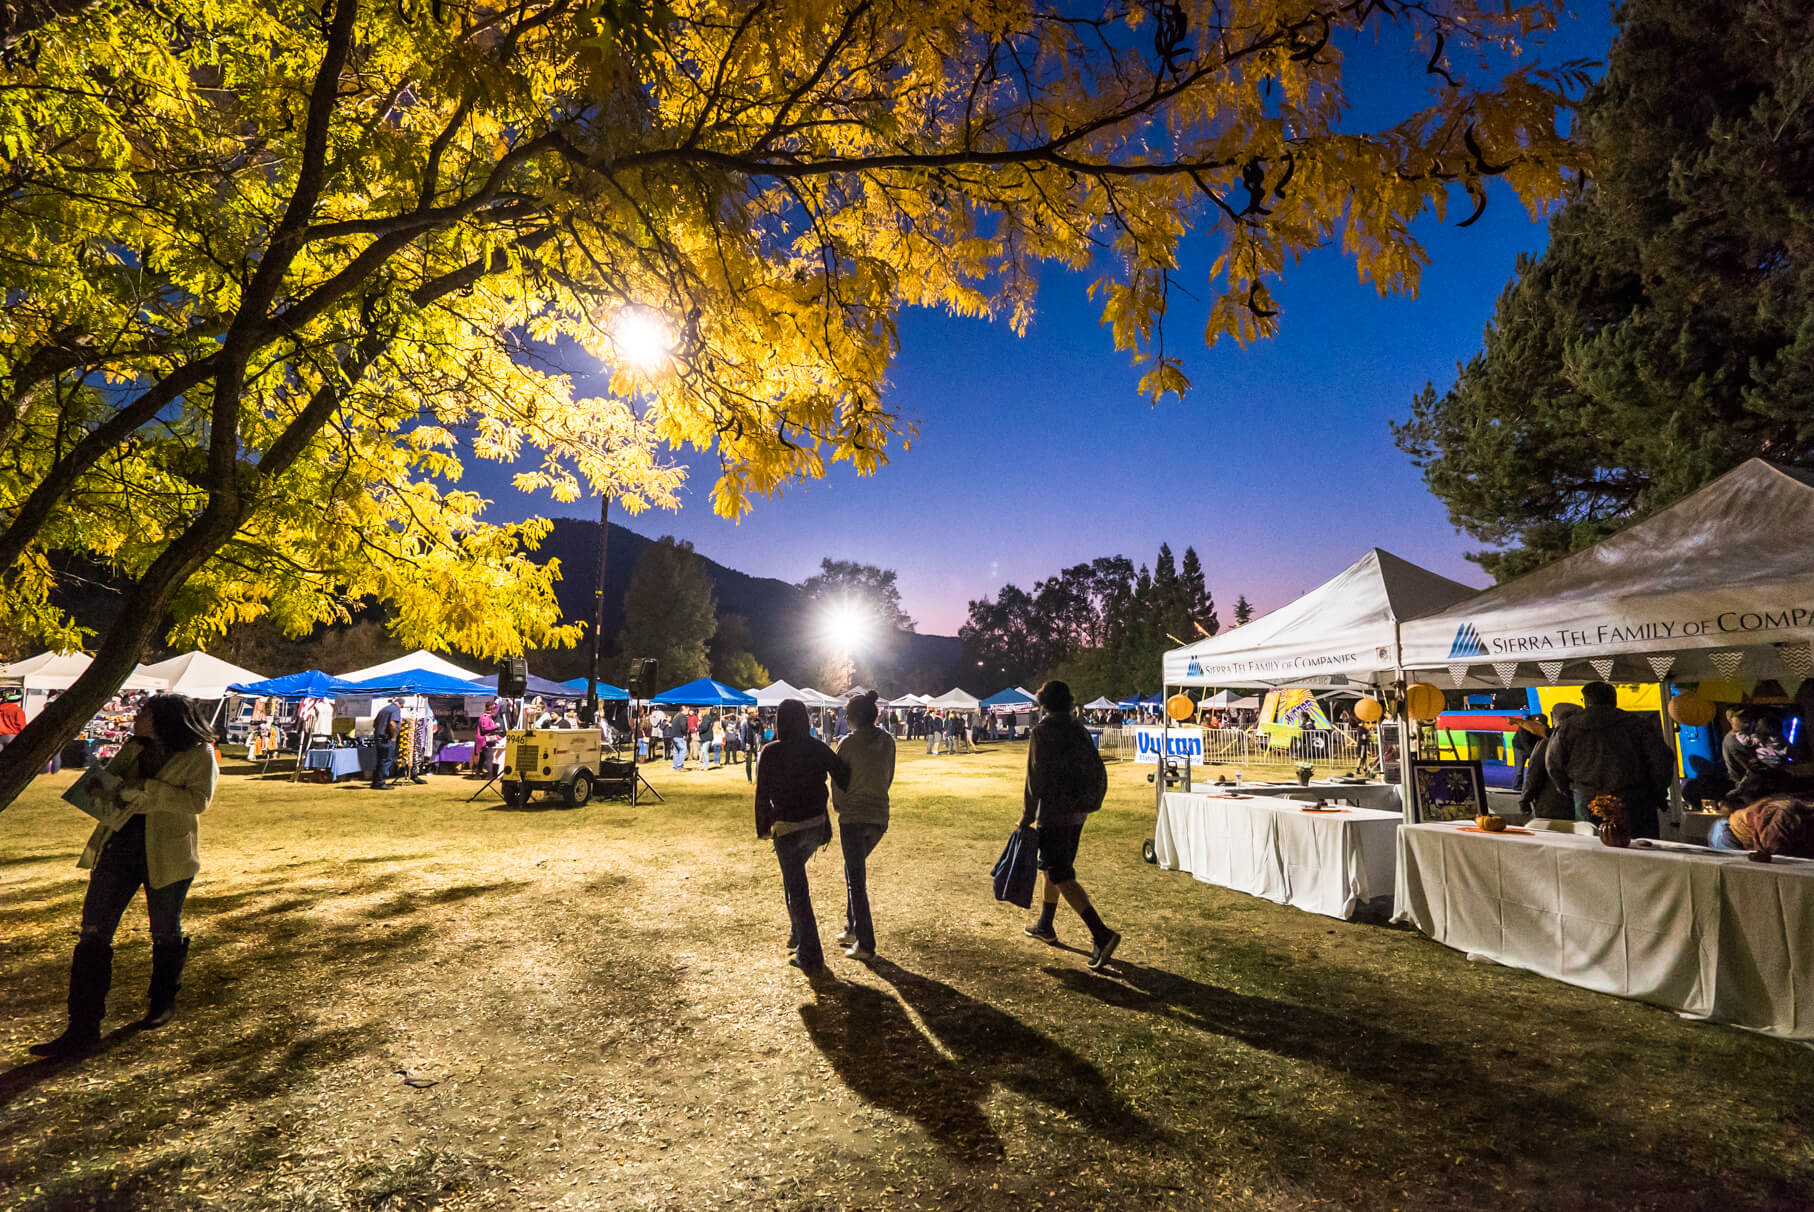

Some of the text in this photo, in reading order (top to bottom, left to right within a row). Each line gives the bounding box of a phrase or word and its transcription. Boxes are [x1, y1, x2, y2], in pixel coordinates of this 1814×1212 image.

[1492, 635, 1554, 654] SIERRA
[1556, 629, 1593, 647] TEL
[1597, 621, 1675, 644] FAMILY
[1683, 619, 1713, 636] OF
[1138, 732, 1201, 755] Vulcan
